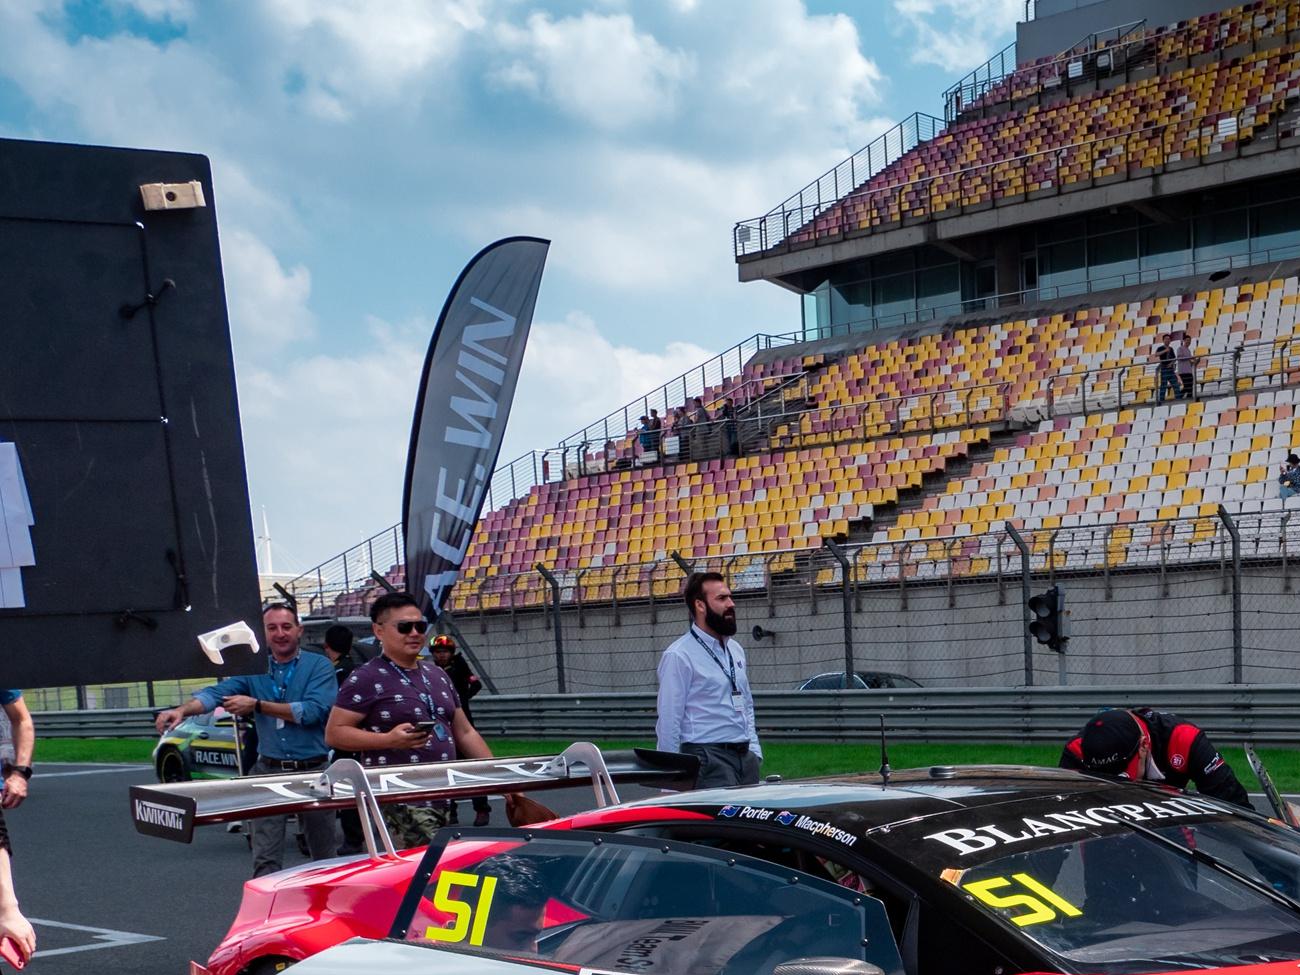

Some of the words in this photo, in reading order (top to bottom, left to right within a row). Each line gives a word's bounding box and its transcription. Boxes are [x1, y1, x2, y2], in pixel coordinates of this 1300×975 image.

[422, 297, 517, 634] ACE.WIN
[738, 806, 774, 820] Porter
[795, 815, 857, 847] Macpherson
[923, 797, 1234, 856] BLANCPAIN
[425, 870, 498, 947] 51
[961, 872, 1083, 927] 51
